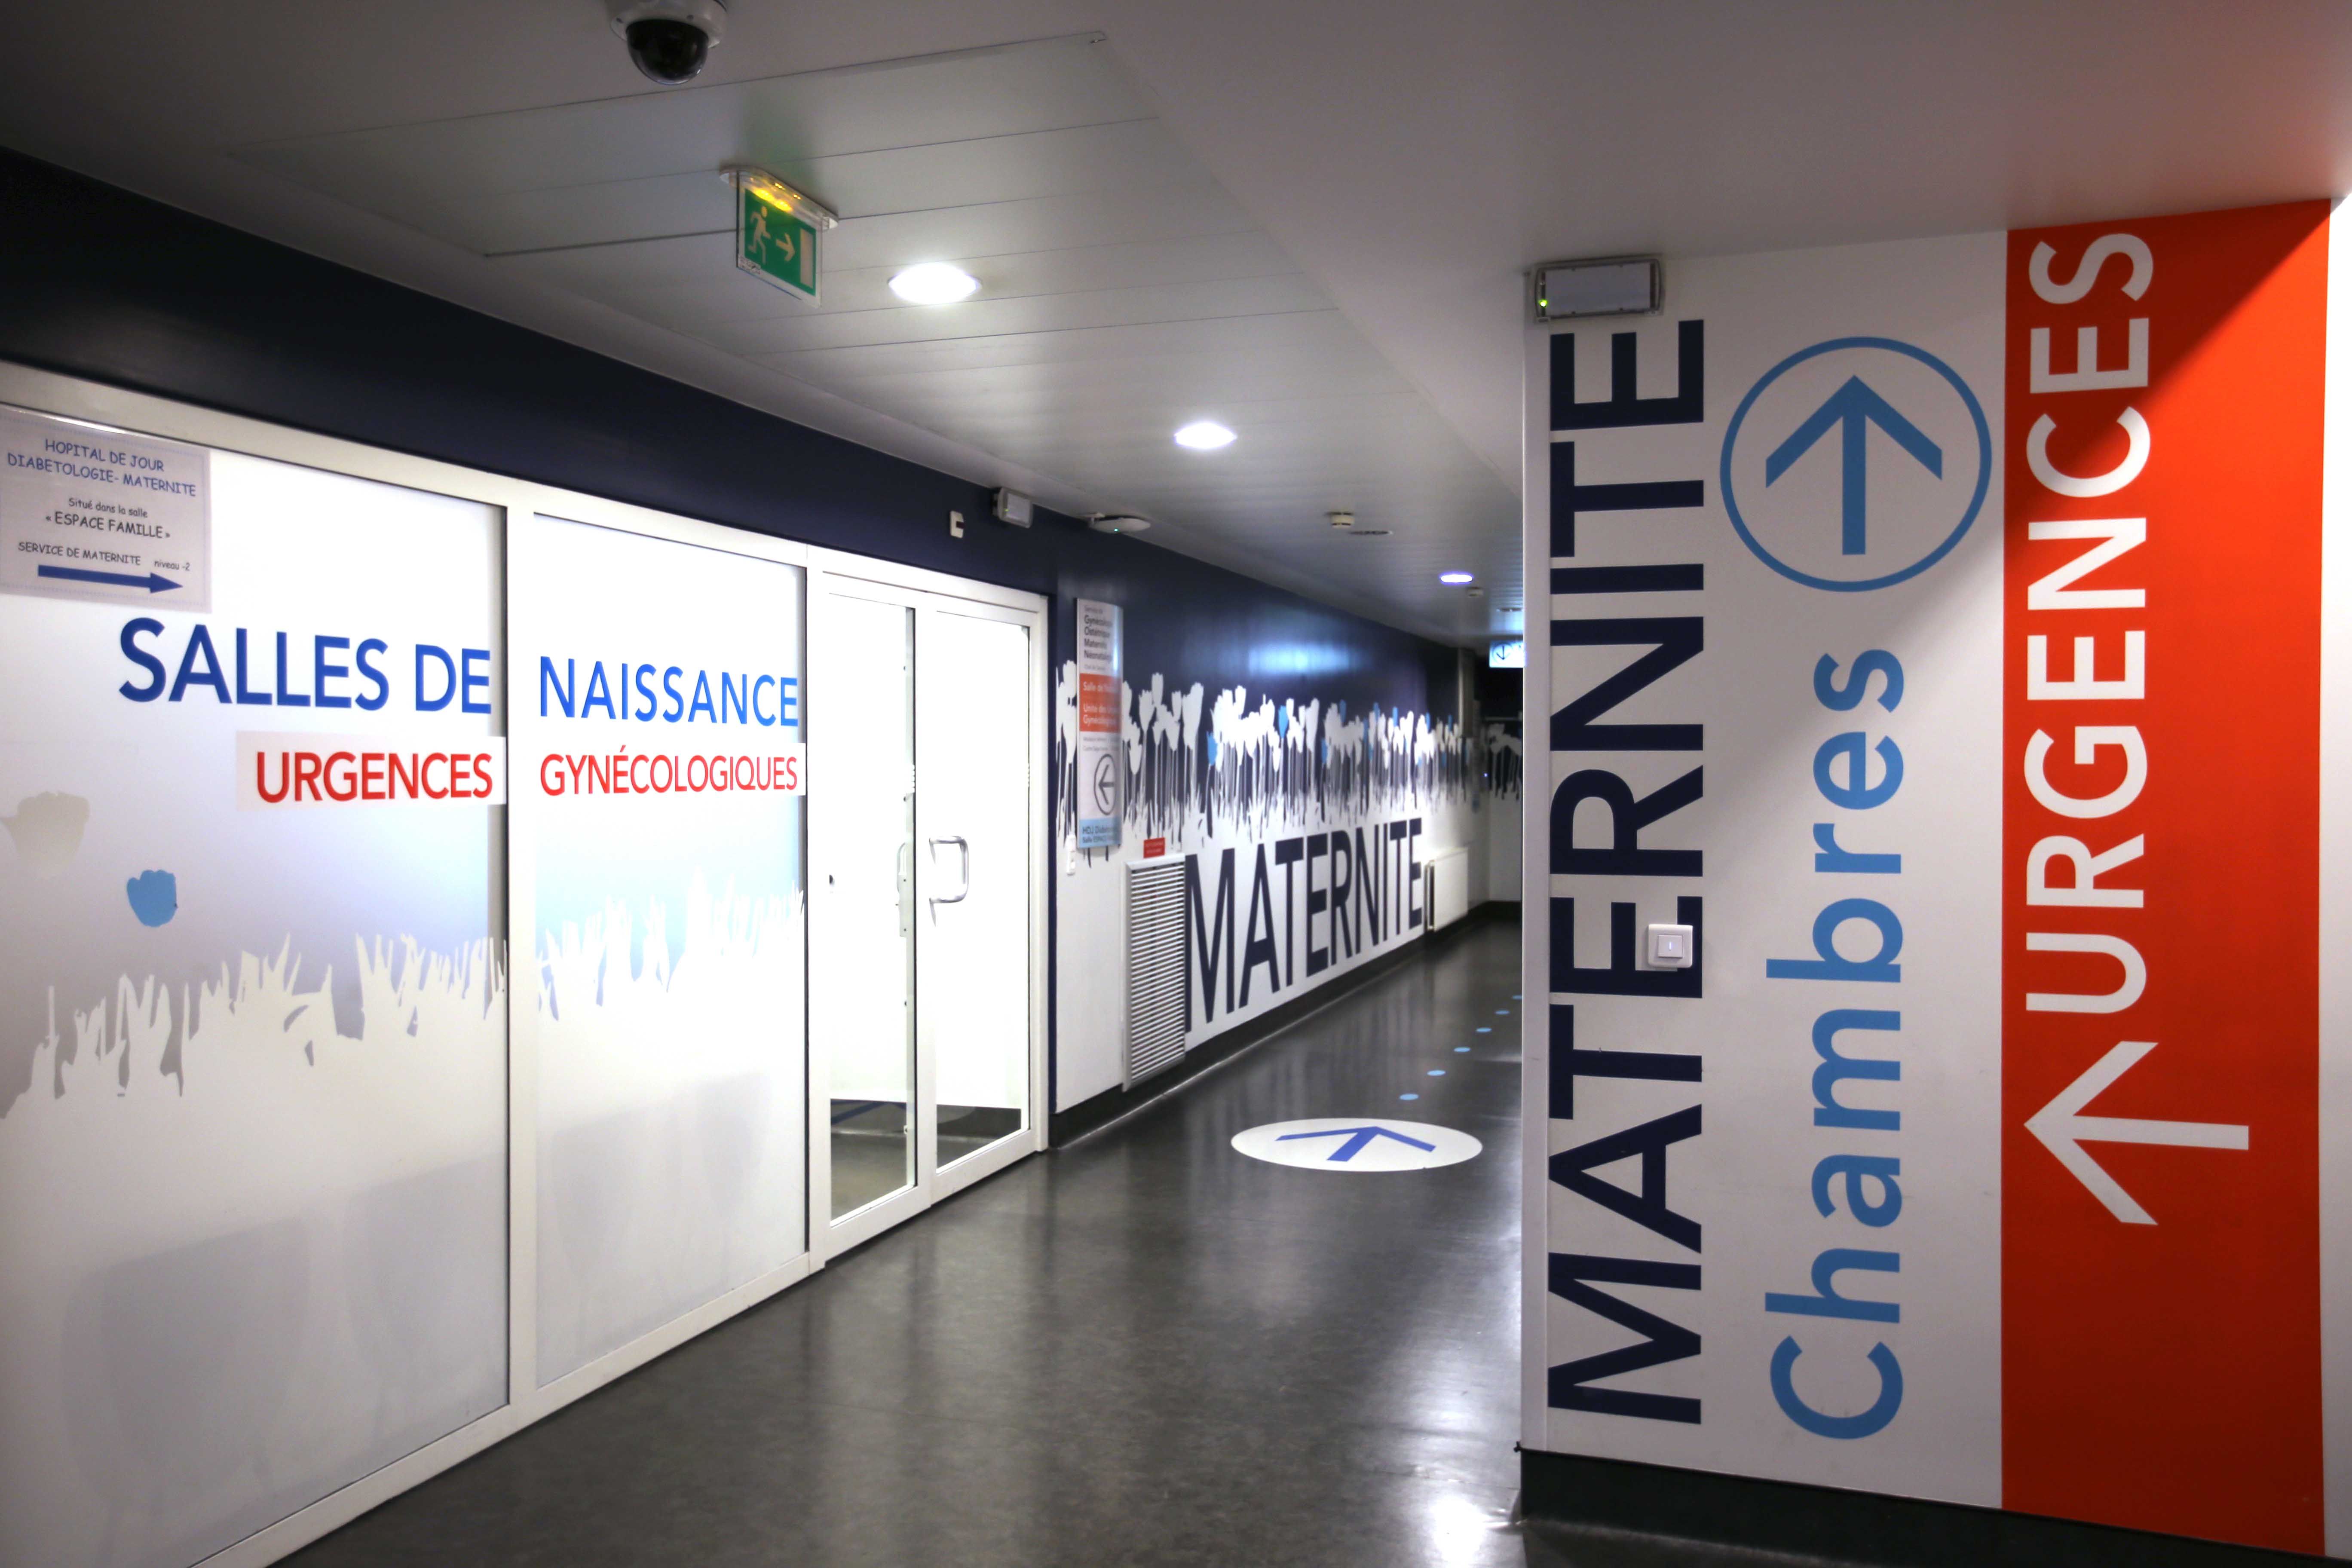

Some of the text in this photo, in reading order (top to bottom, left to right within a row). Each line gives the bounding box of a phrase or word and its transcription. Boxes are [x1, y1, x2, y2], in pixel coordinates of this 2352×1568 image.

[45, 438, 164, 472] HOPITAL DE JOUR
[69, 497, 147, 518] Situé dans la salle
[123, 473, 196, 496] MATERNITE
[55, 511, 104, 531] ESPACE
[108, 519, 163, 539] FAMILLE
[18, 542, 64, 557] SERVICE
[67, 547, 80, 558] DE
[83, 549, 141, 566] MATERNITE
[154, 560, 180, 571] niveau
[2024, 233, 2153, 1014] URGENCES
[119, 617, 799, 727] SALLES DE NAISSANCE
[257, 745, 798, 803] URGENCES GYNÉCOLOGIQUES
[1547, 319, 1704, 1425] MATERNITE
[1185, 817, 1422, 1033] MATERNITE
[1765, 649, 1904, 1440] Chambres
